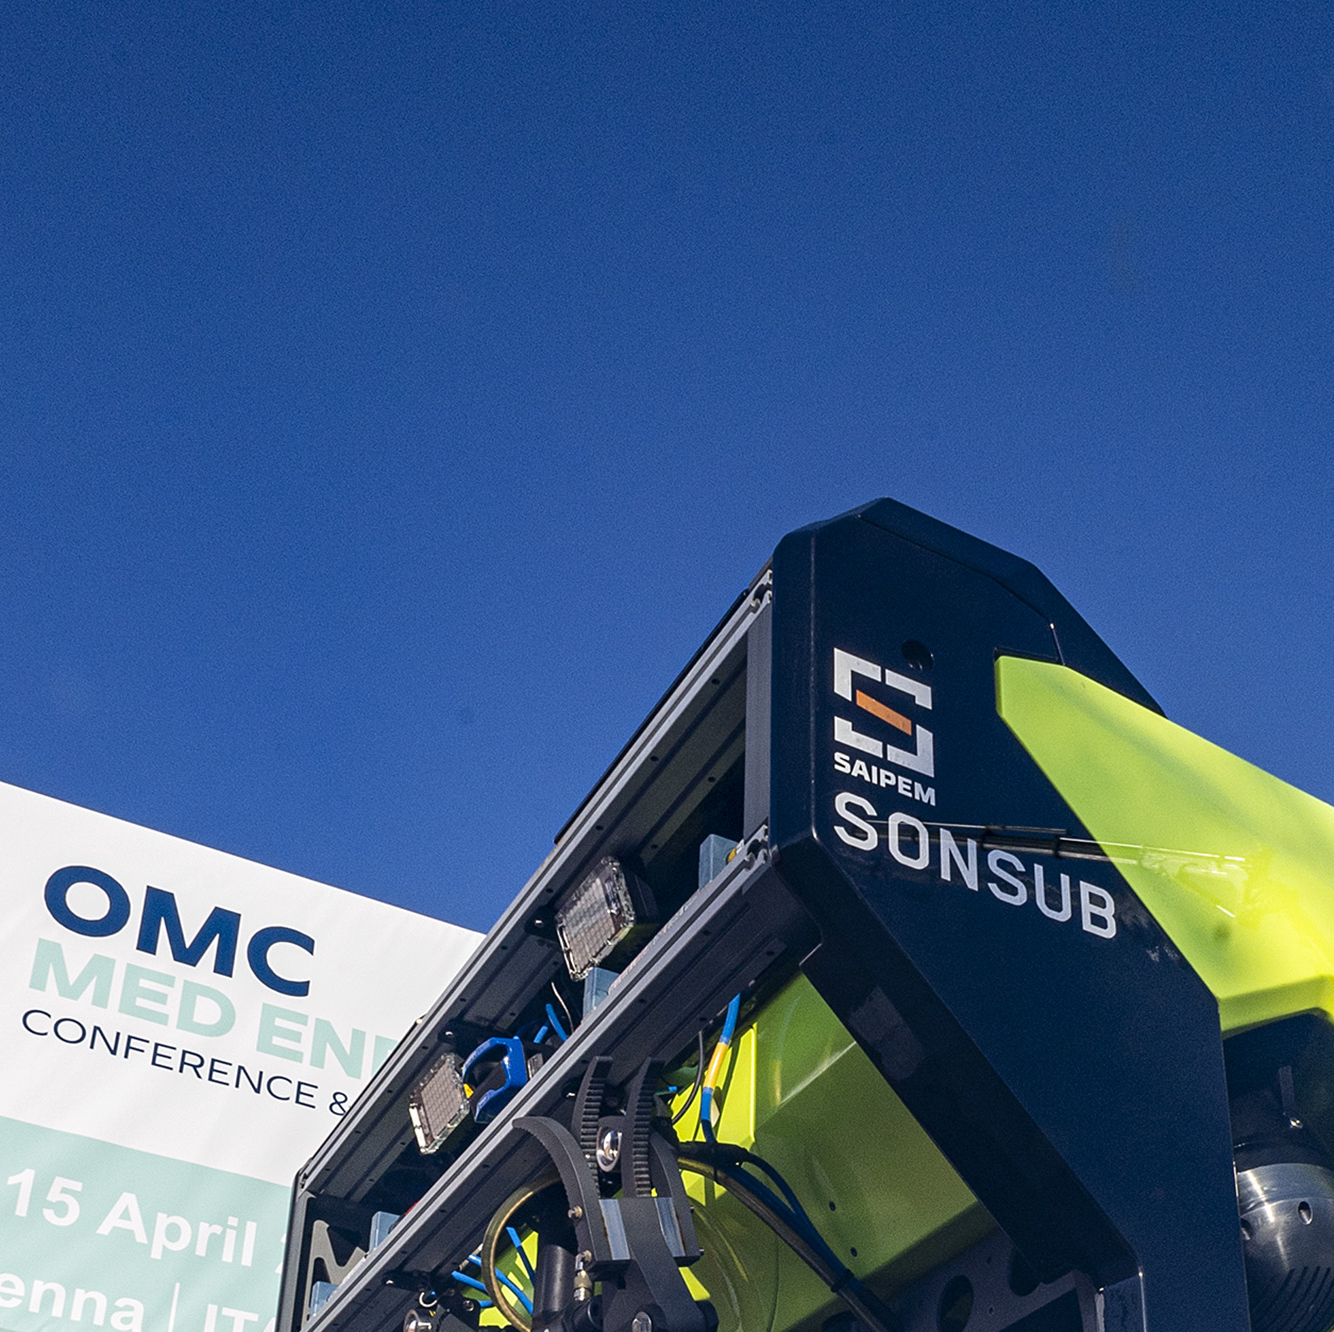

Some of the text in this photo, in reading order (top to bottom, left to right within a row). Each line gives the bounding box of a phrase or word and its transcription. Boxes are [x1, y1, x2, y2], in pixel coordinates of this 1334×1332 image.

[833, 751, 937, 807] SAIPEM
[833, 792, 1118, 940] SONSUB
[43, 864, 316, 997] OMC
[26, 937, 237, 1040] MED
[20, 1008, 350, 1116] CONFERENCE &
[5, 1167, 83, 1228] 15
[95, 1190, 258, 1269] April
